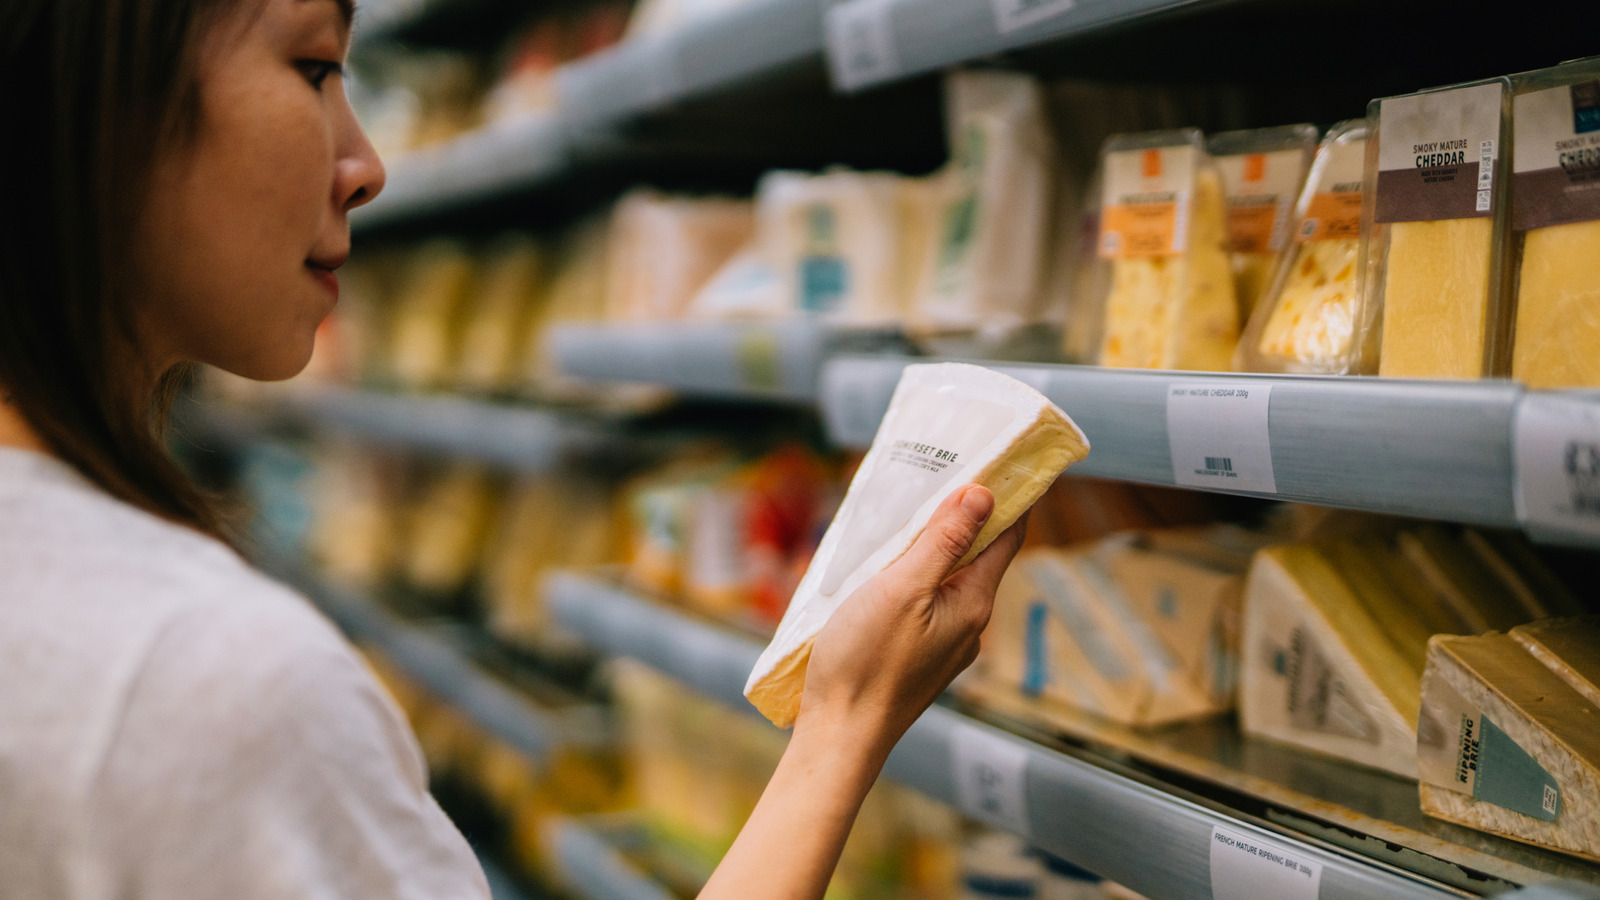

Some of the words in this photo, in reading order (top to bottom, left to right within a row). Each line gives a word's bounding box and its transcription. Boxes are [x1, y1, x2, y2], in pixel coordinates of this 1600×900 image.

[1413, 142, 1438, 154] SMOKY
[1440, 139, 1467, 151] MATURE
[1416, 151, 1465, 168] CHEDDAR
[1210, 389, 1235, 397] CHEDDAR
[1236, 389, 1249, 399] 200g
[935, 448, 959, 463] BRIE
[1460, 718, 1474, 783] RIPENING
[1468, 739, 1480, 771] BRIE
[1215, 832, 1236, 847] FRENCH
[1236, 840, 1258, 856] MATURE
[1259, 848, 1284, 866] RIPENING
[1285, 858, 1298, 871] BRIE
